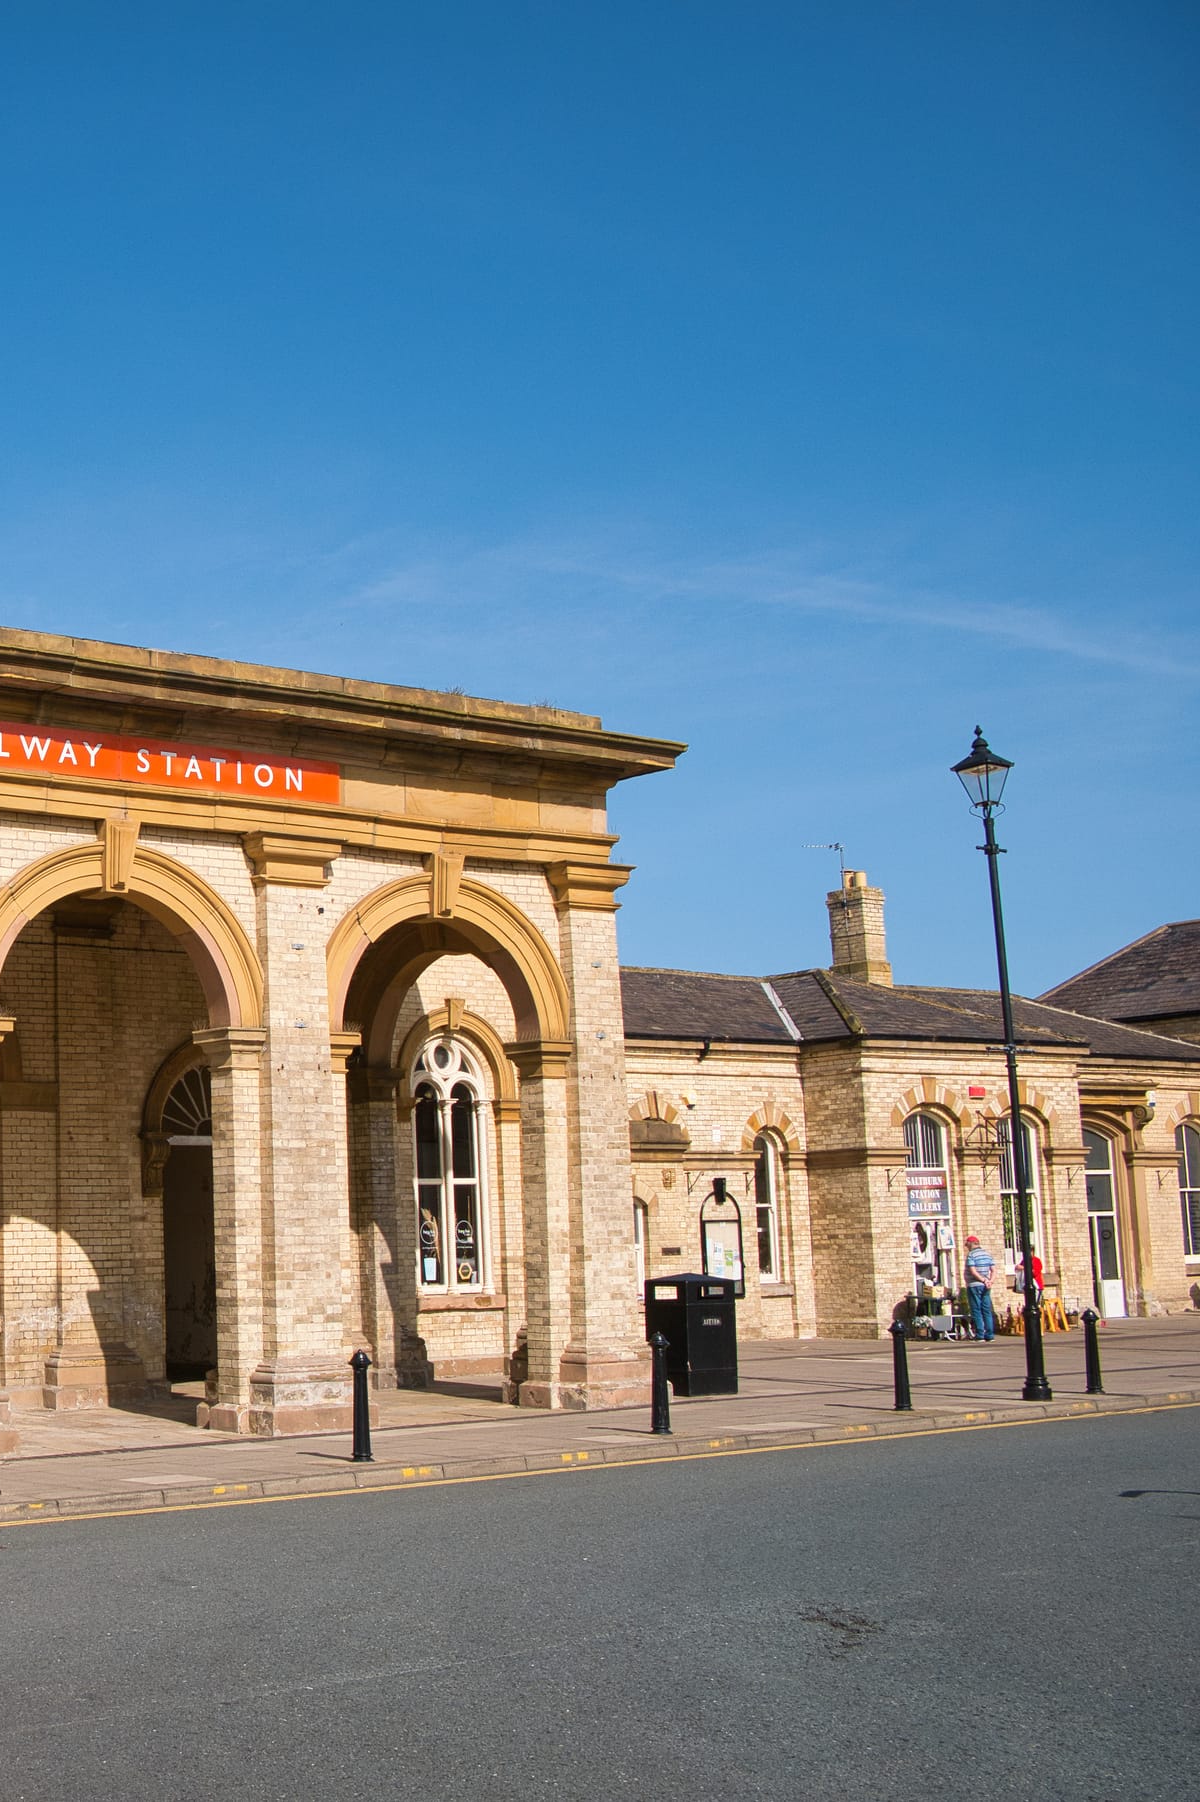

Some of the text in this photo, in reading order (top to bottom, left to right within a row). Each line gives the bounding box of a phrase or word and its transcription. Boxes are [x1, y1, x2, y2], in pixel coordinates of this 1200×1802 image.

[136, 748, 302, 791] STATION
[910, 1189, 940, 1198] STATION
[910, 1202, 942, 1212] GALLERY
